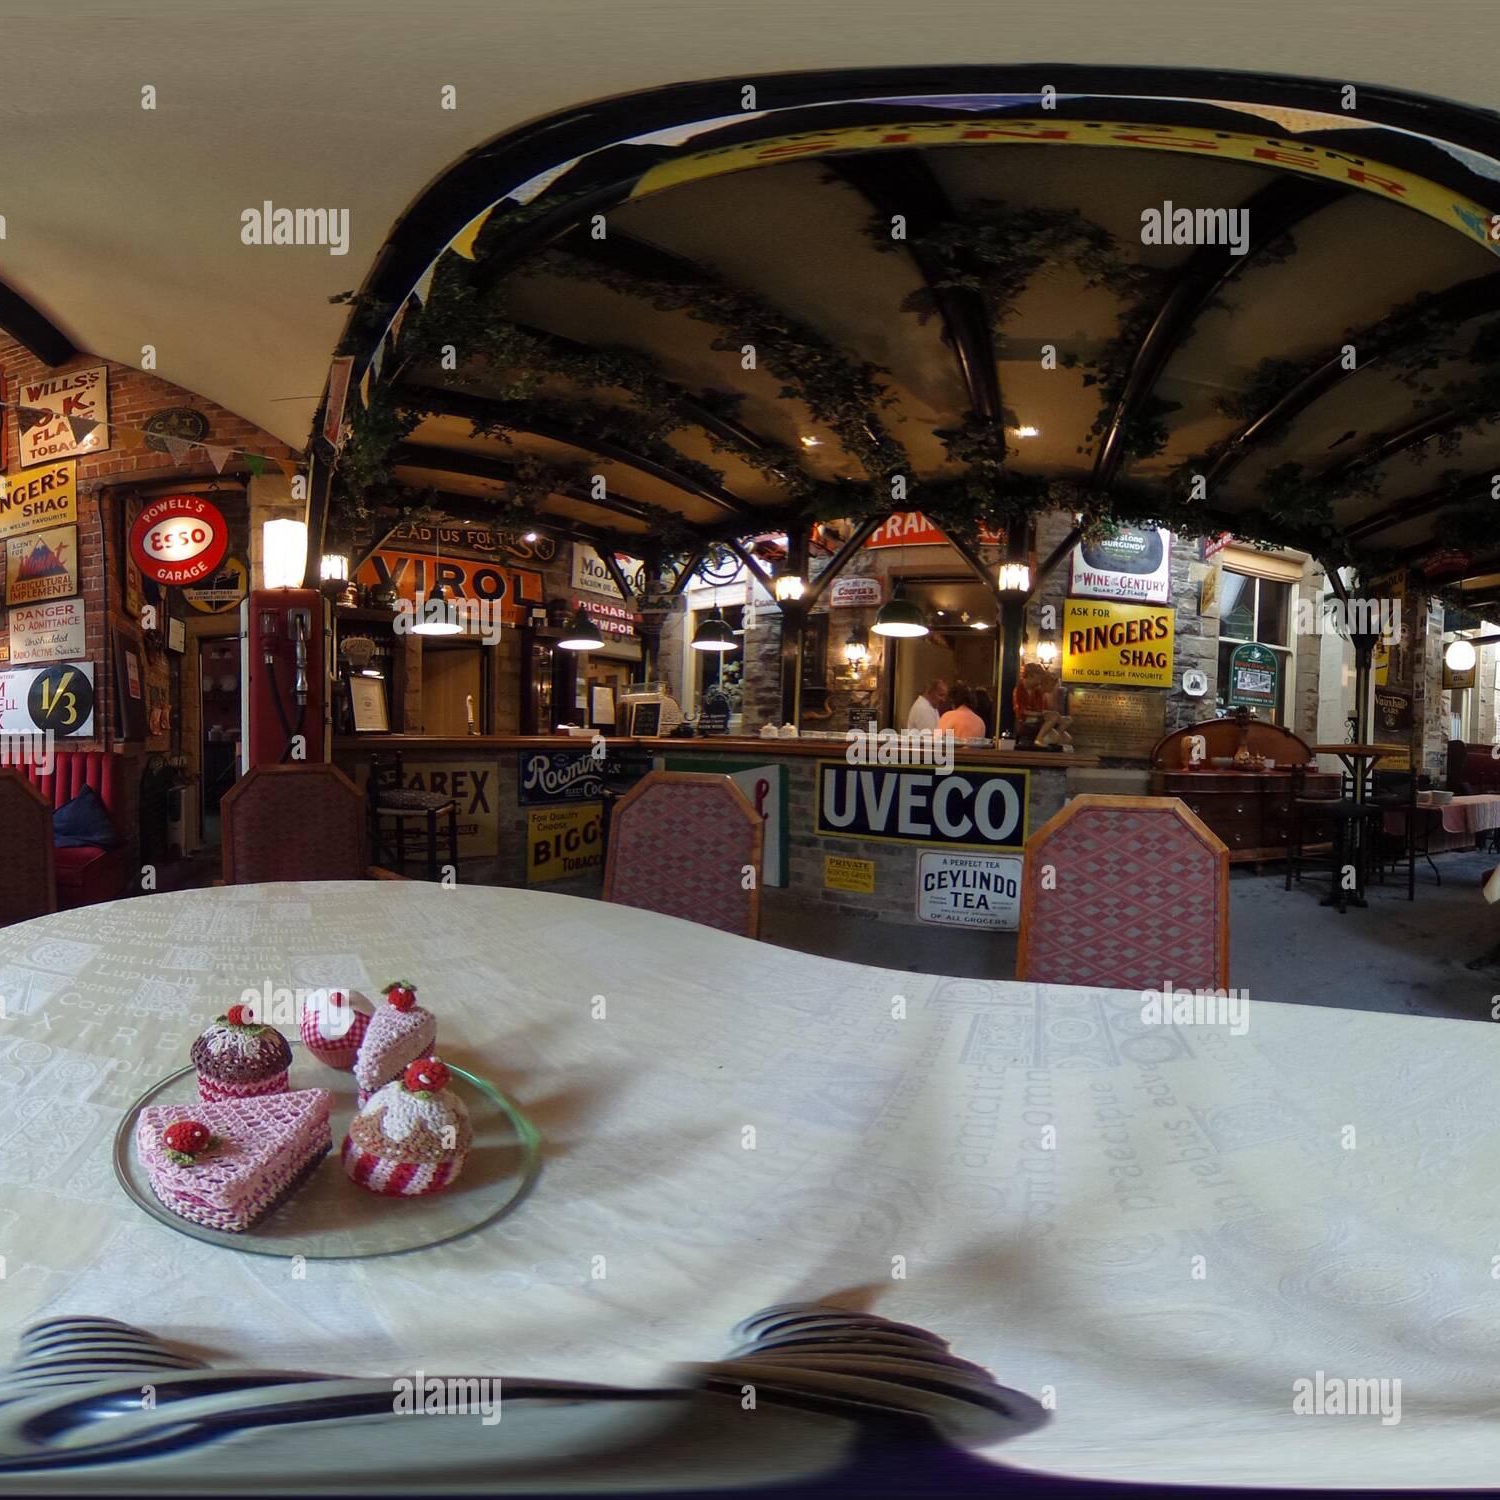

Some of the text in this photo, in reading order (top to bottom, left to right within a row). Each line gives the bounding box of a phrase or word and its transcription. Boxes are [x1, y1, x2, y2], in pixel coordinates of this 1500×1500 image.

[22, 495, 70, 519] SHAG
[142, 498, 205, 524] POWELL'S
[9, 521, 31, 533] WELSH
[32, 512, 69, 527] FAVOURITE
[439, 529, 461, 542] US
[1101, 540, 1146, 551] BURGUNDY
[156, 560, 209, 582] GARAGE
[10, 575, 72, 594] AGRICULTURAL
[371, 555, 528, 608] VIROL
[1083, 572, 1166, 593] WINE CENTURY
[10, 583, 74, 602] IMPLEMENTS
[16, 604, 75, 622] DANGER
[1070, 607, 1111, 618] ASK FOR
[13, 615, 81, 634] NO ADMITTANCE
[1068, 614, 1169, 656] RINGER'S
[1118, 649, 1168, 669] SHAG
[1071, 668, 1164, 682] THE OLD WELSH FAVOURITE
[41, 671, 79, 726] 1/3
[822, 768, 1021, 842] UVECO
[531, 811, 580, 823] FOR QUALITY
[536, 822, 569, 832] CHOOSE
[829, 857, 871, 871] PRIVATE
[941, 858, 1001, 869] A PERFECT TEA
[924, 869, 1017, 899] CEYLINDO
[950, 891, 990, 911] TEA
[930, 912, 942, 920] OF
[964, 916, 1008, 926] GROCERS
